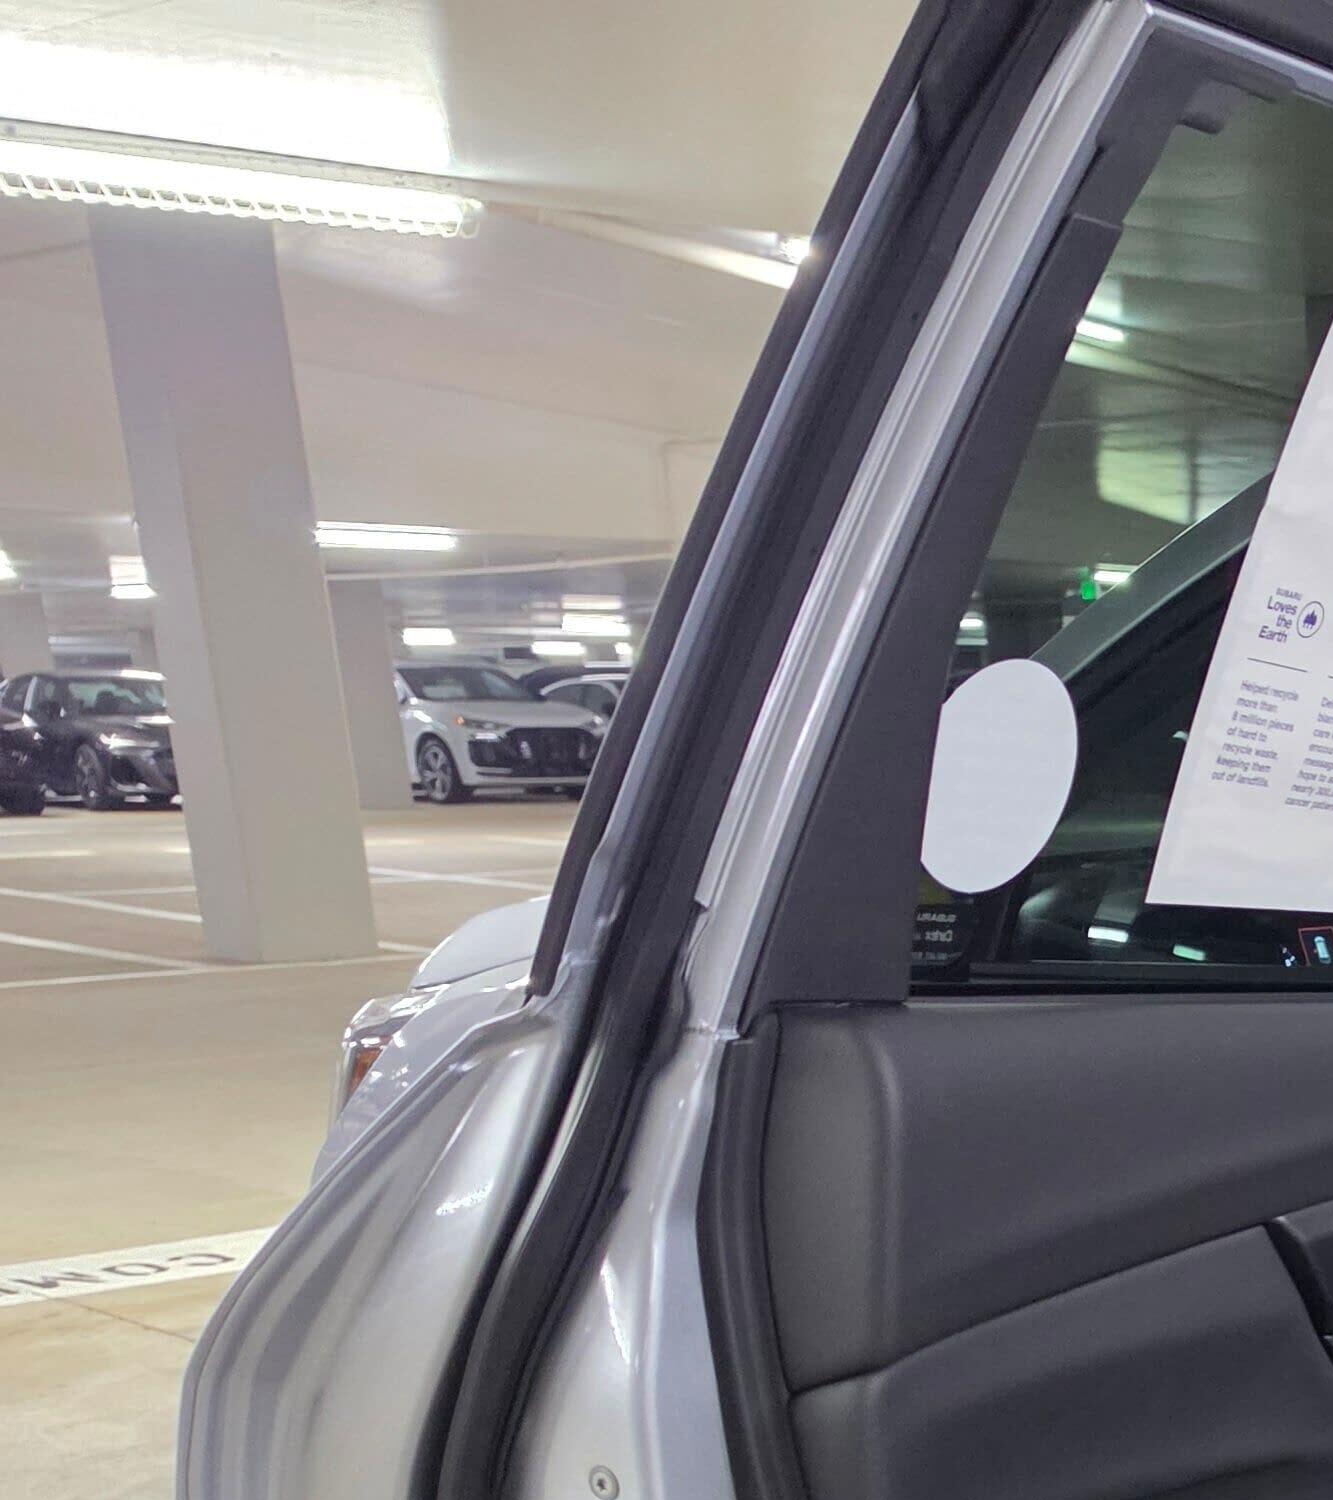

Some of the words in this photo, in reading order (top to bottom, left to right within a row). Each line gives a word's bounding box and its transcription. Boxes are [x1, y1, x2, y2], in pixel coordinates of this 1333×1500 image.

[1267, 596, 1298, 615] Loves
[1276, 615, 1292, 629] the
[1258, 626, 1287, 642] Earth
